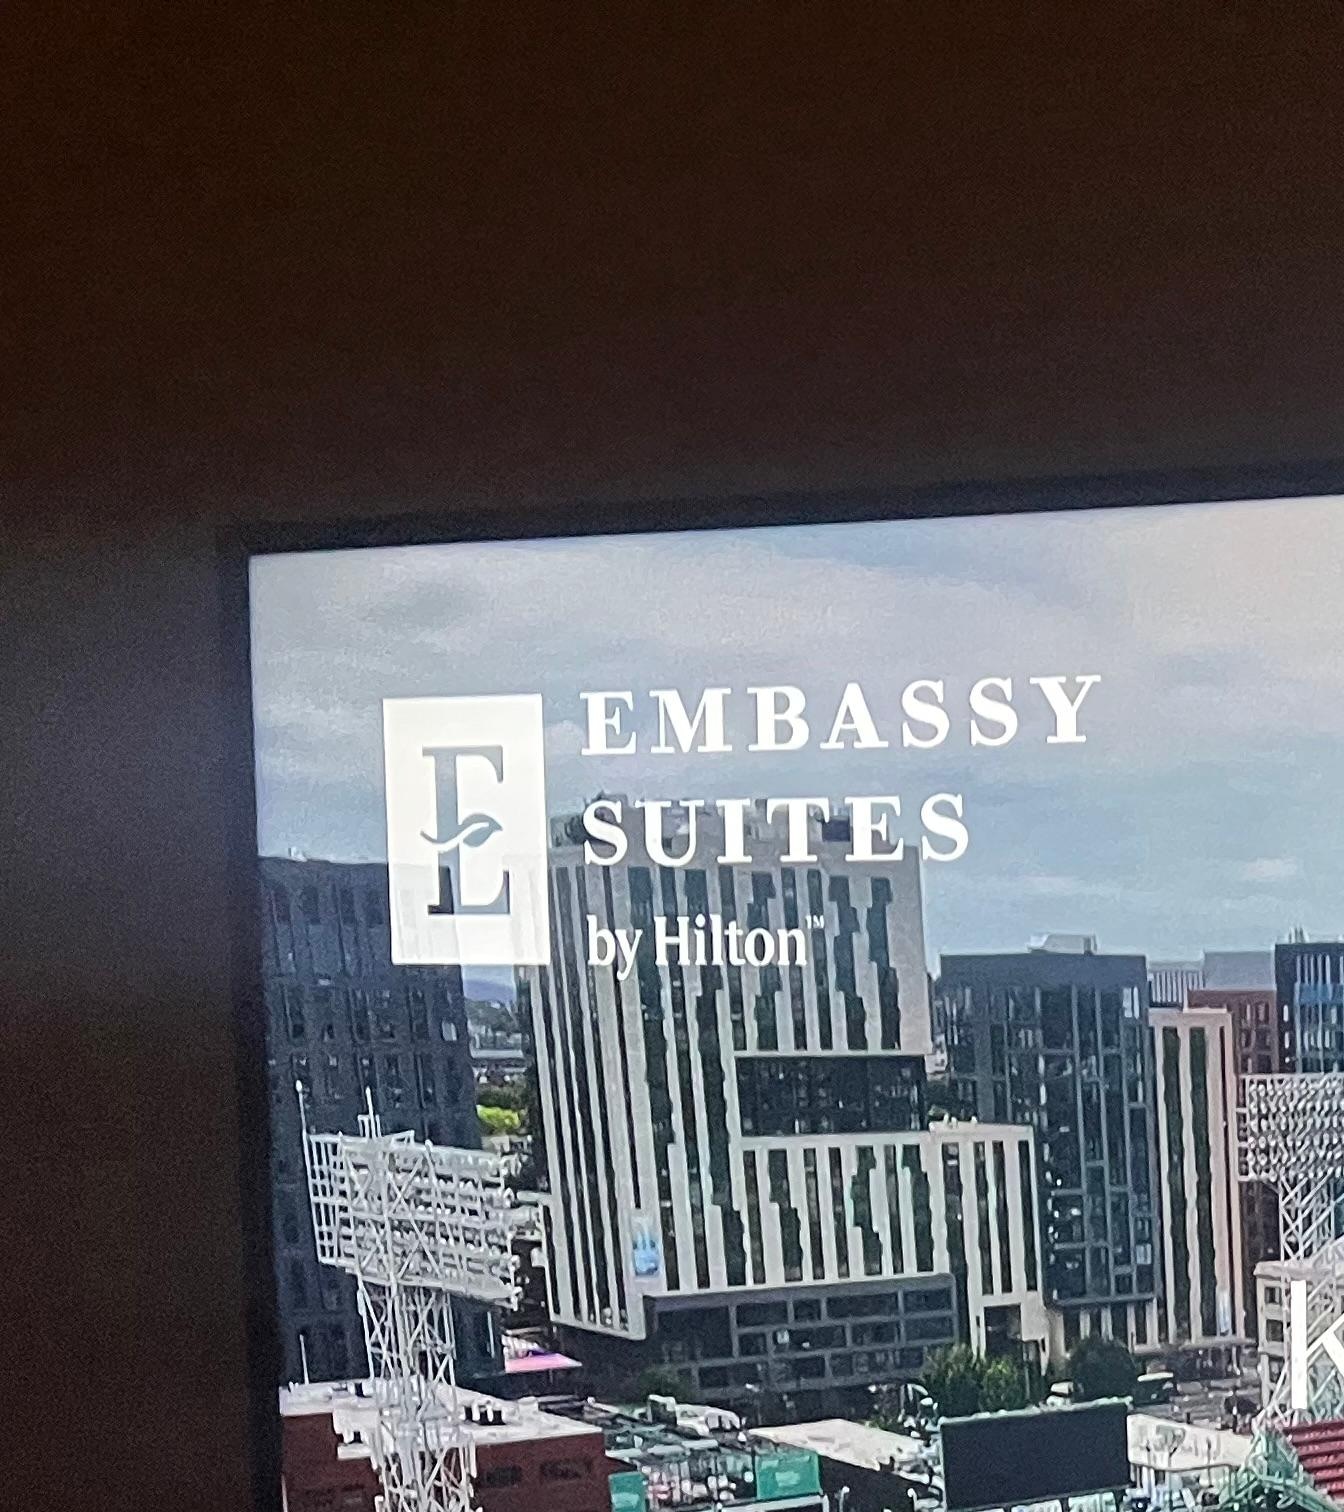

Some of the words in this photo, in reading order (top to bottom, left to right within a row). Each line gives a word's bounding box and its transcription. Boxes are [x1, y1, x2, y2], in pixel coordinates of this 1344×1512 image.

[579, 673, 1101, 756] EMBASSY
[581, 792, 970, 867] SUITES
[586, 914, 643, 981] by
